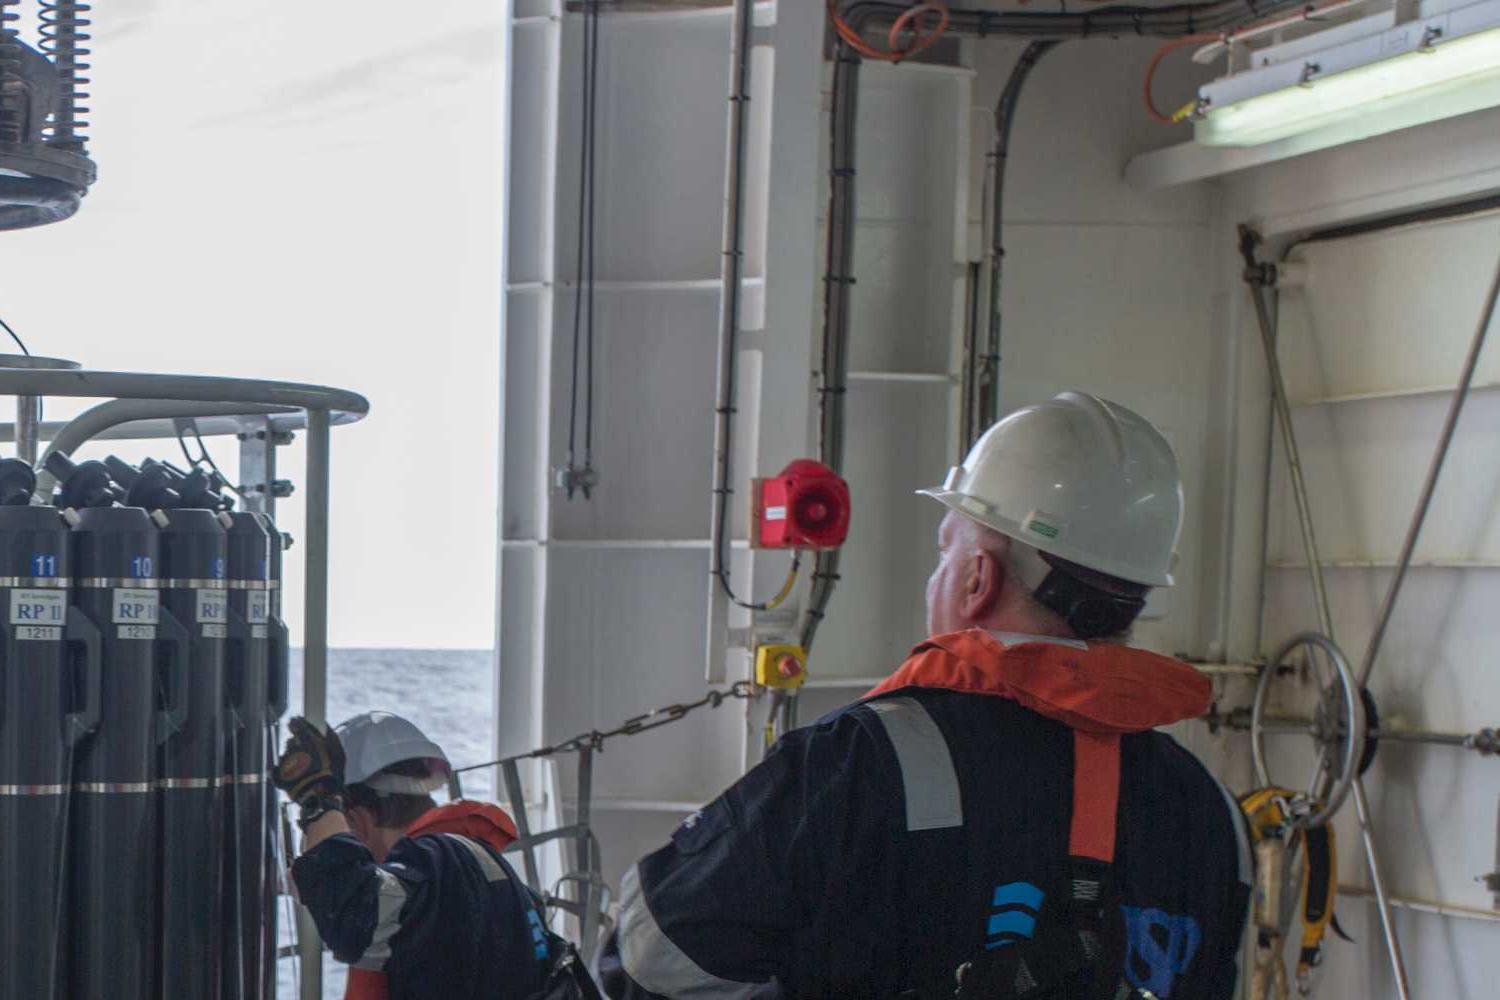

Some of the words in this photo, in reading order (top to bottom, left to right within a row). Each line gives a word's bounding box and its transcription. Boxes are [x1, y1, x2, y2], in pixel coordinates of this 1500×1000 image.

[36, 556, 55, 575] 11
[134, 558, 151, 577] 10
[18, 604, 44, 620] RP
[119, 603, 145, 619] RP
[26, 628, 54, 639] 1211
